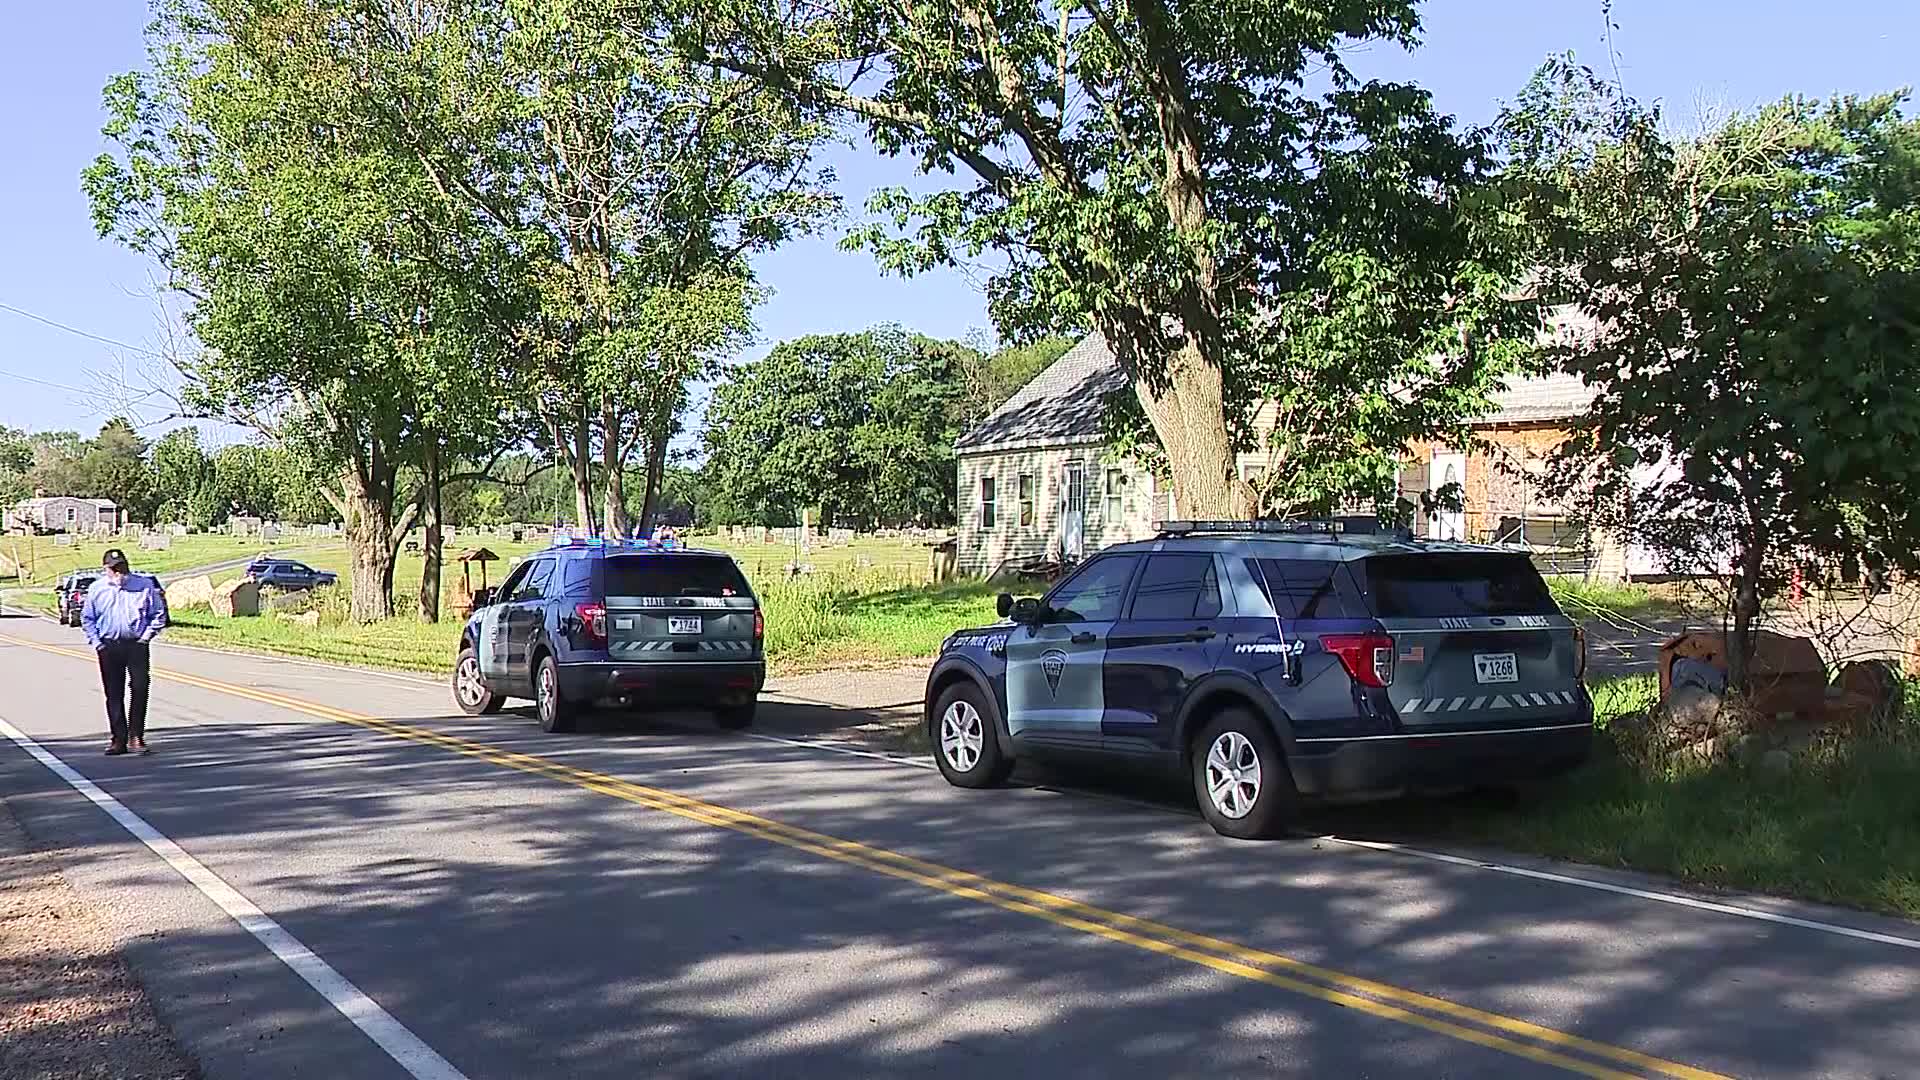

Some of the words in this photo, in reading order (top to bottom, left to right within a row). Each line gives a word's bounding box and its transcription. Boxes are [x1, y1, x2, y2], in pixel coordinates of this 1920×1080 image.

[642, 597, 665, 606] STATE
[703, 596, 726, 607] POLICE
[1439, 617, 1472, 629] STATE
[1518, 615, 1550, 627] POLICE
[1234, 644, 1292, 653] HYBRID
[1045, 661, 1062, 670] STATE
[1490, 661, 1513, 675] 1268
